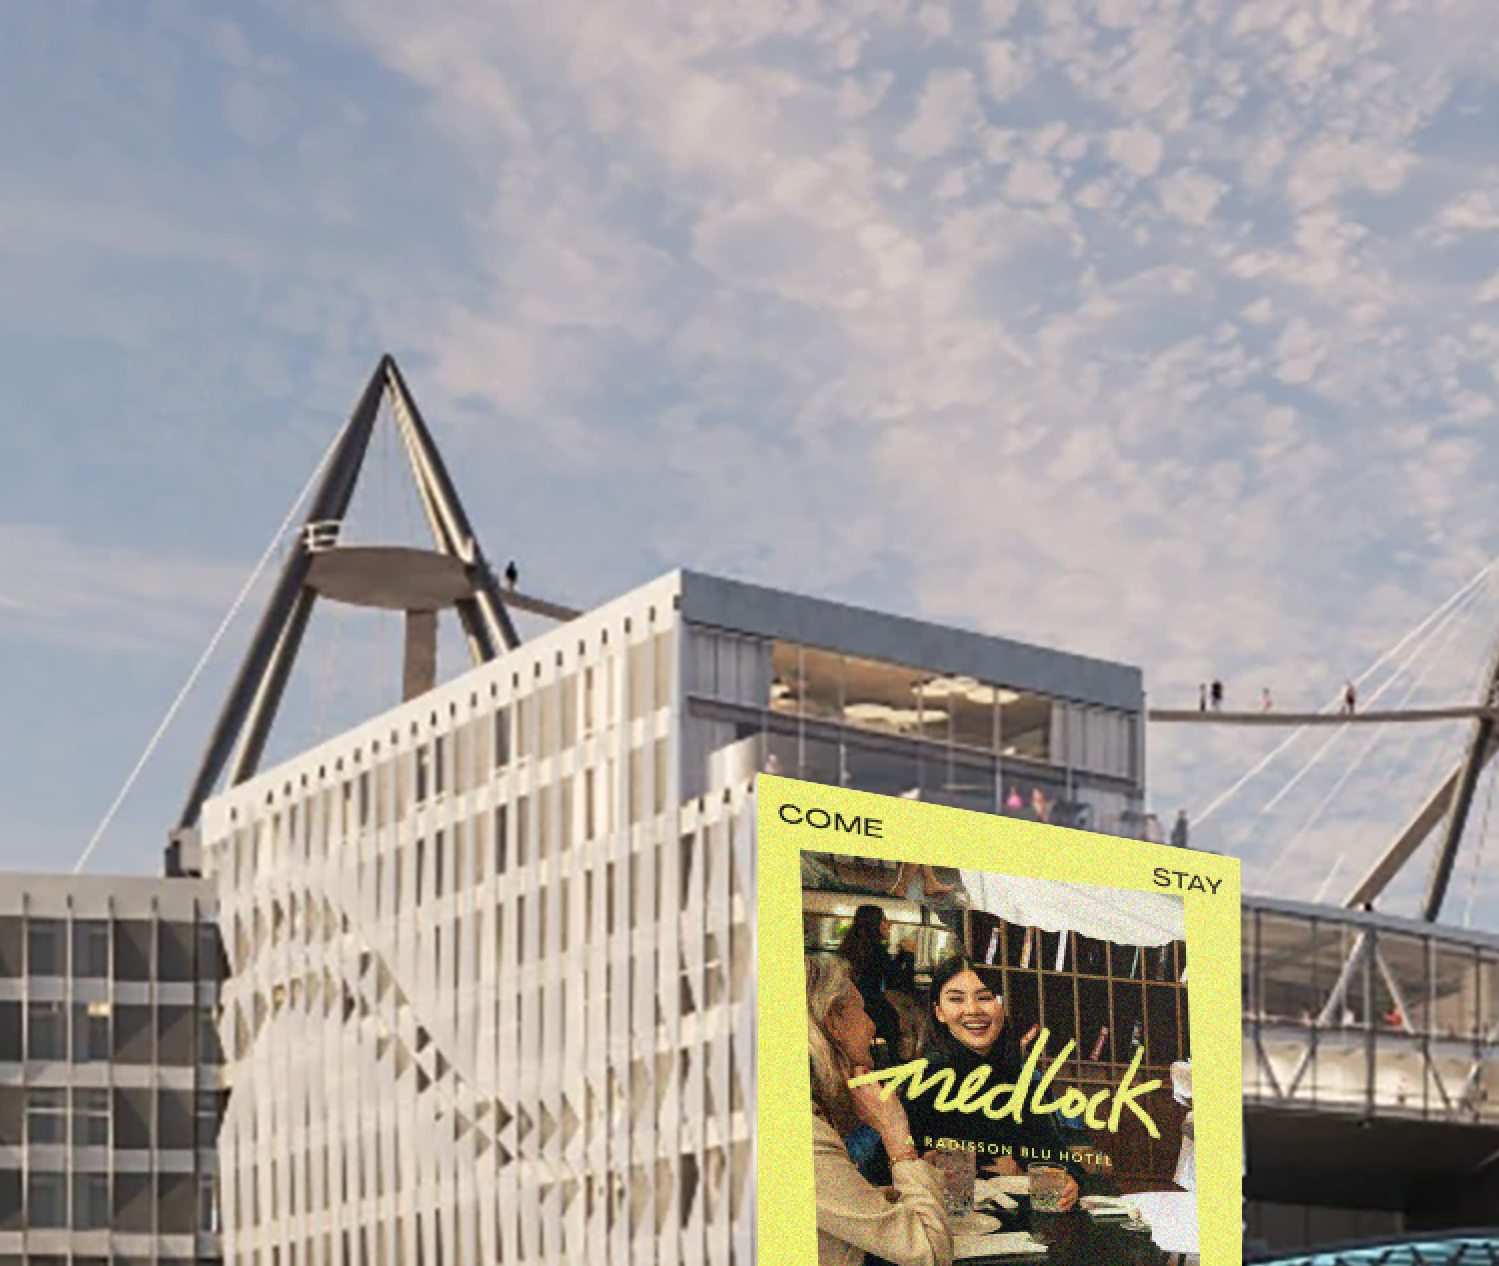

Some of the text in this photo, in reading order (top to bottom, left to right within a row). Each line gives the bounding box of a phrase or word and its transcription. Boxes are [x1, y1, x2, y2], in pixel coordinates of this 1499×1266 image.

[778, 803, 884, 839] COME
[1152, 867, 1223, 896] STAY
[848, 1027, 1162, 1138] medlock
[924, 1136, 1012, 1155] RADISSON
[1021, 1147, 1051, 1160] BLU
[1060, 1151, 1113, 1167] HOTEL
